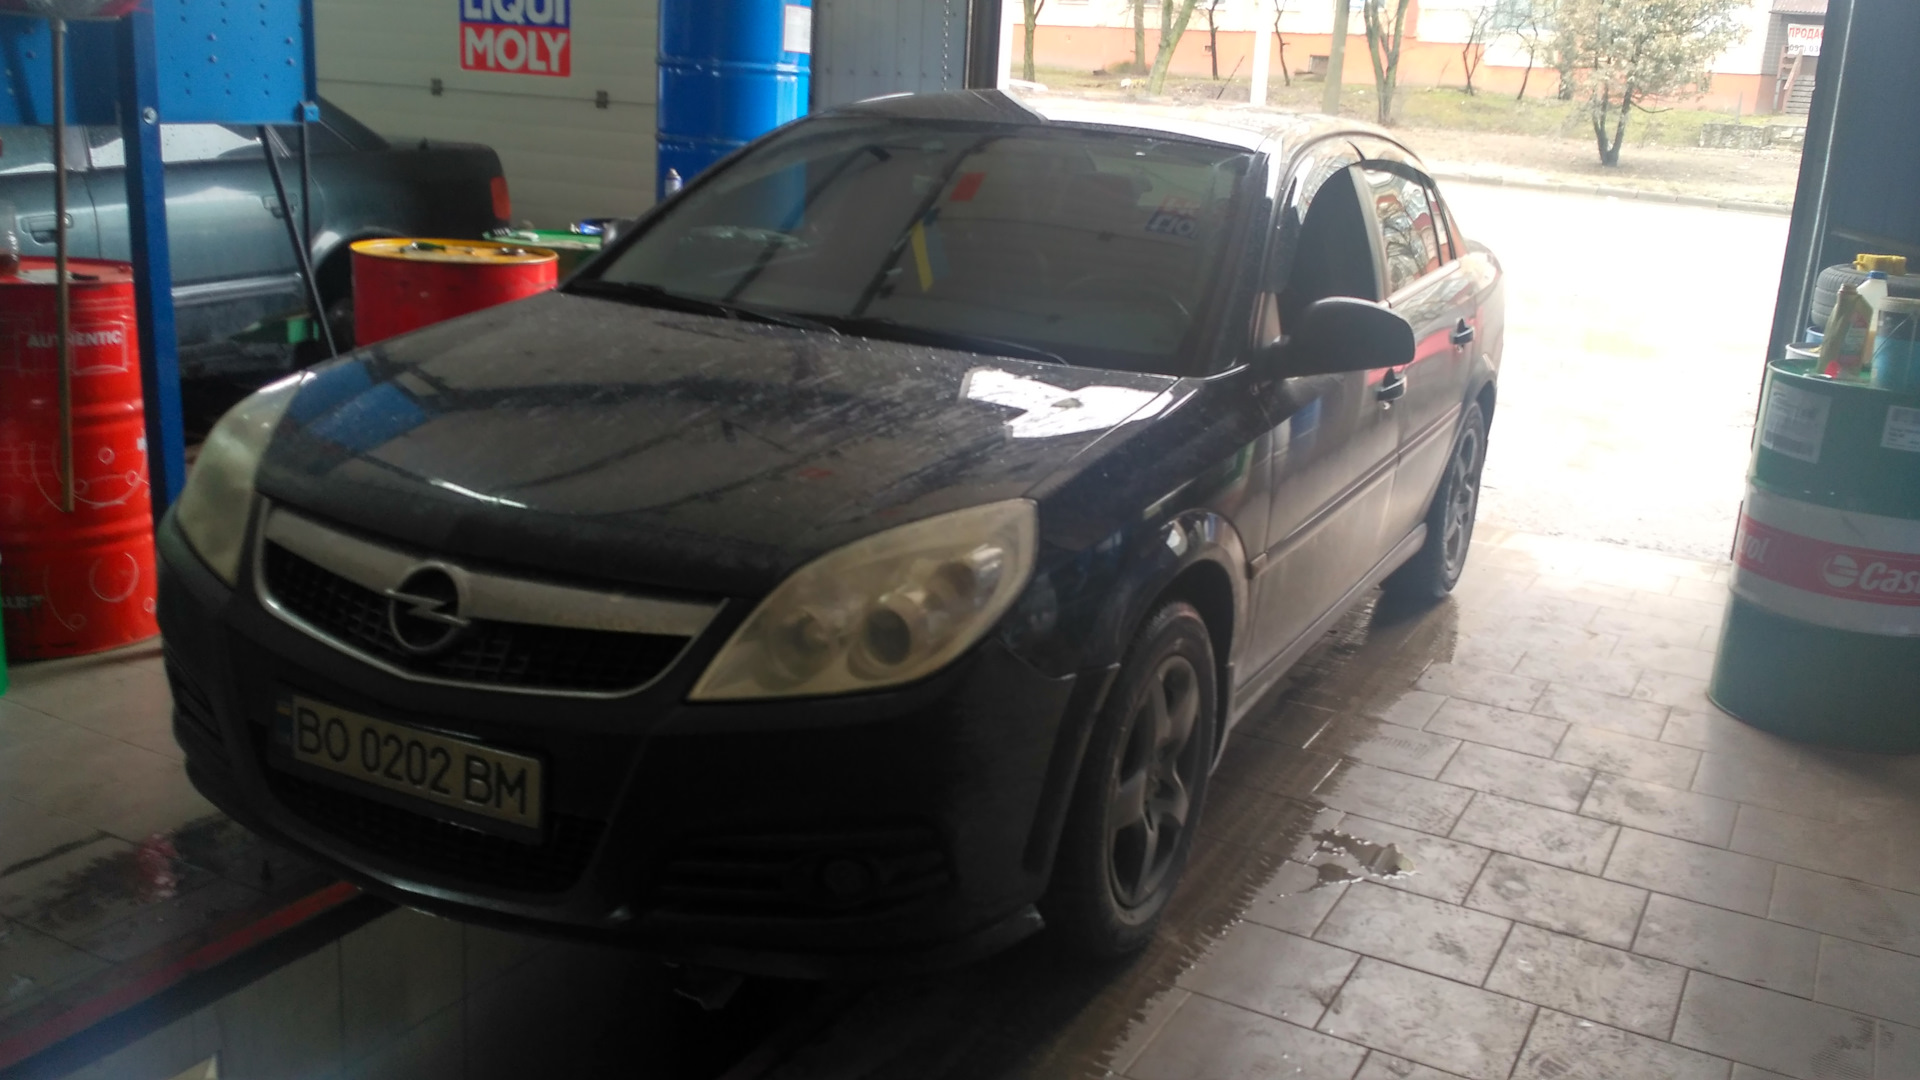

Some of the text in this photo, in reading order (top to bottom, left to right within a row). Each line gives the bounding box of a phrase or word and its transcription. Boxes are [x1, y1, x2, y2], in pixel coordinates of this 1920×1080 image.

[465, 26, 568, 73] MOLY
[296, 706, 527, 815] BO 0202 BM
